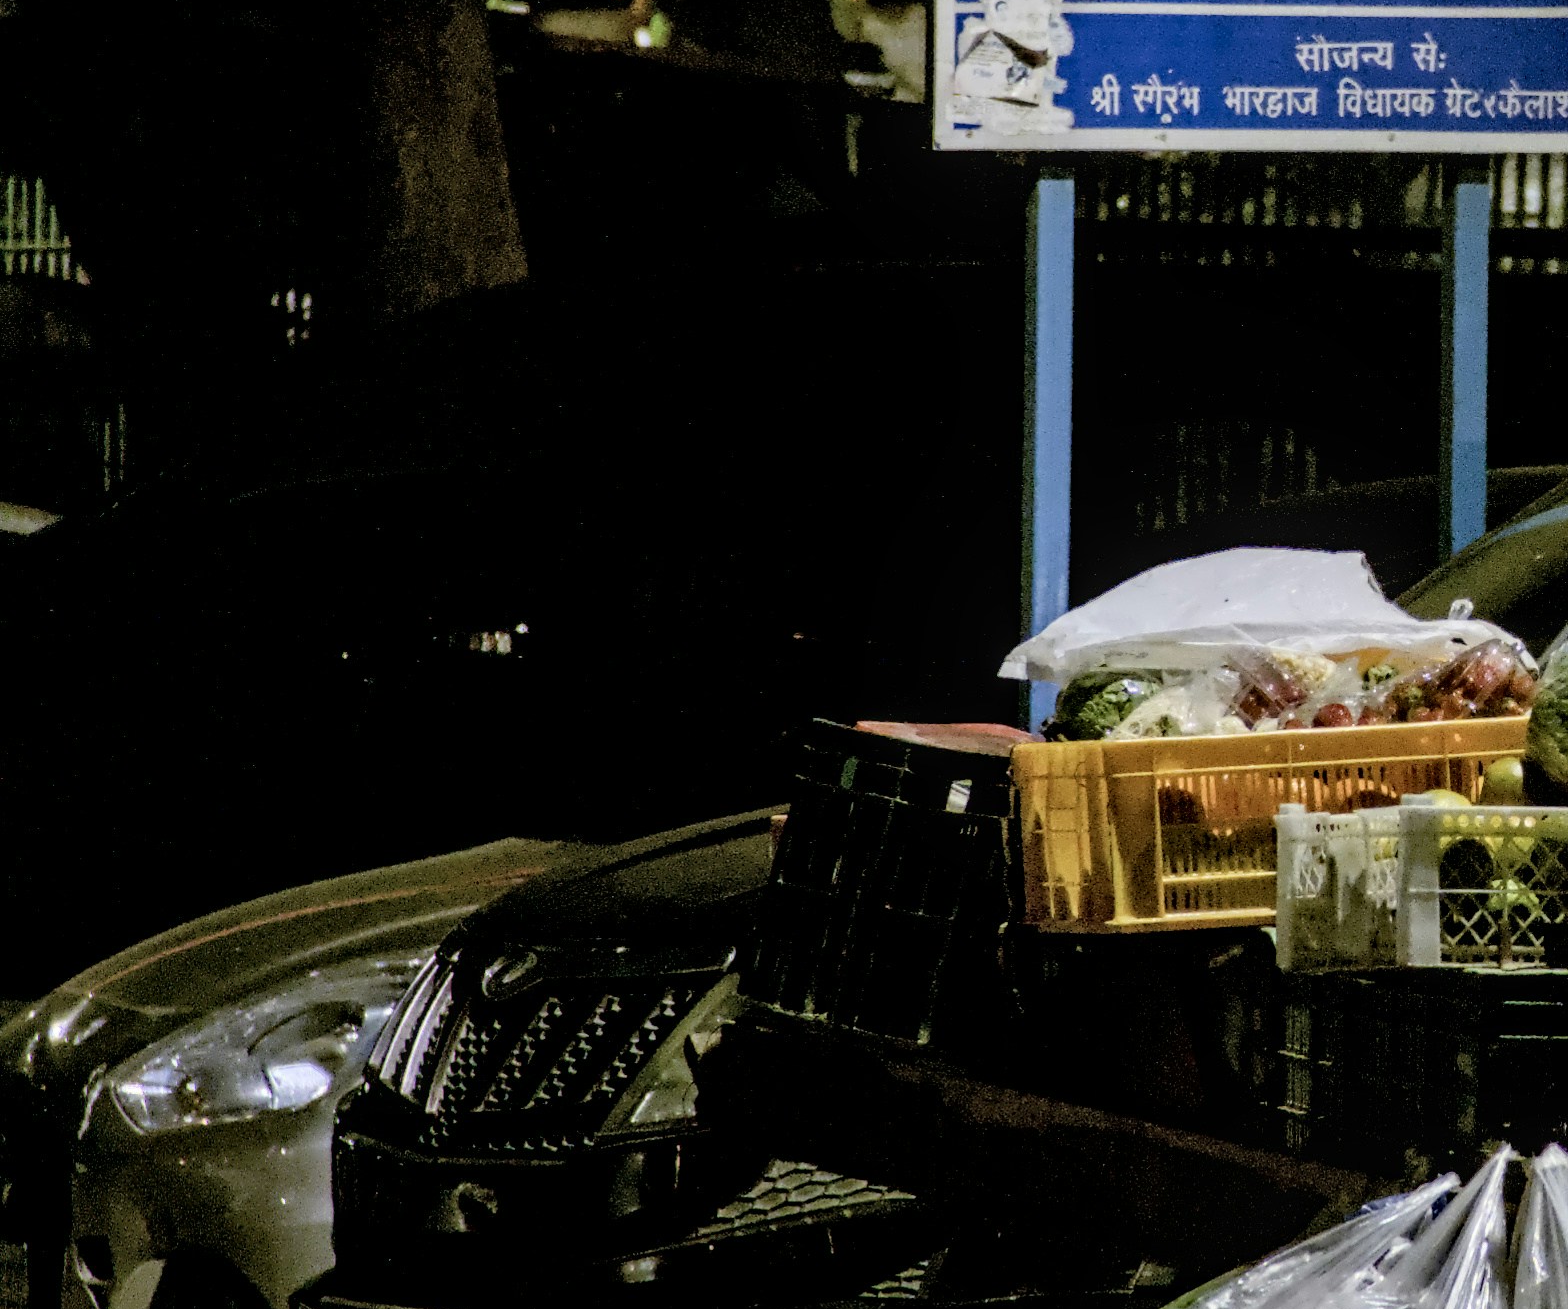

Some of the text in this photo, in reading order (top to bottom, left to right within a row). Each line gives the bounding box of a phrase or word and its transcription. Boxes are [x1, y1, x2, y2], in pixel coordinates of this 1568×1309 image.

[1295, 34, 1395, 73] सौजन्य
[1090, 73, 1121, 116] श्री
[1222, 86, 1320, 119] भारद्वाज
[1336, 77, 1437, 119] विधायक
